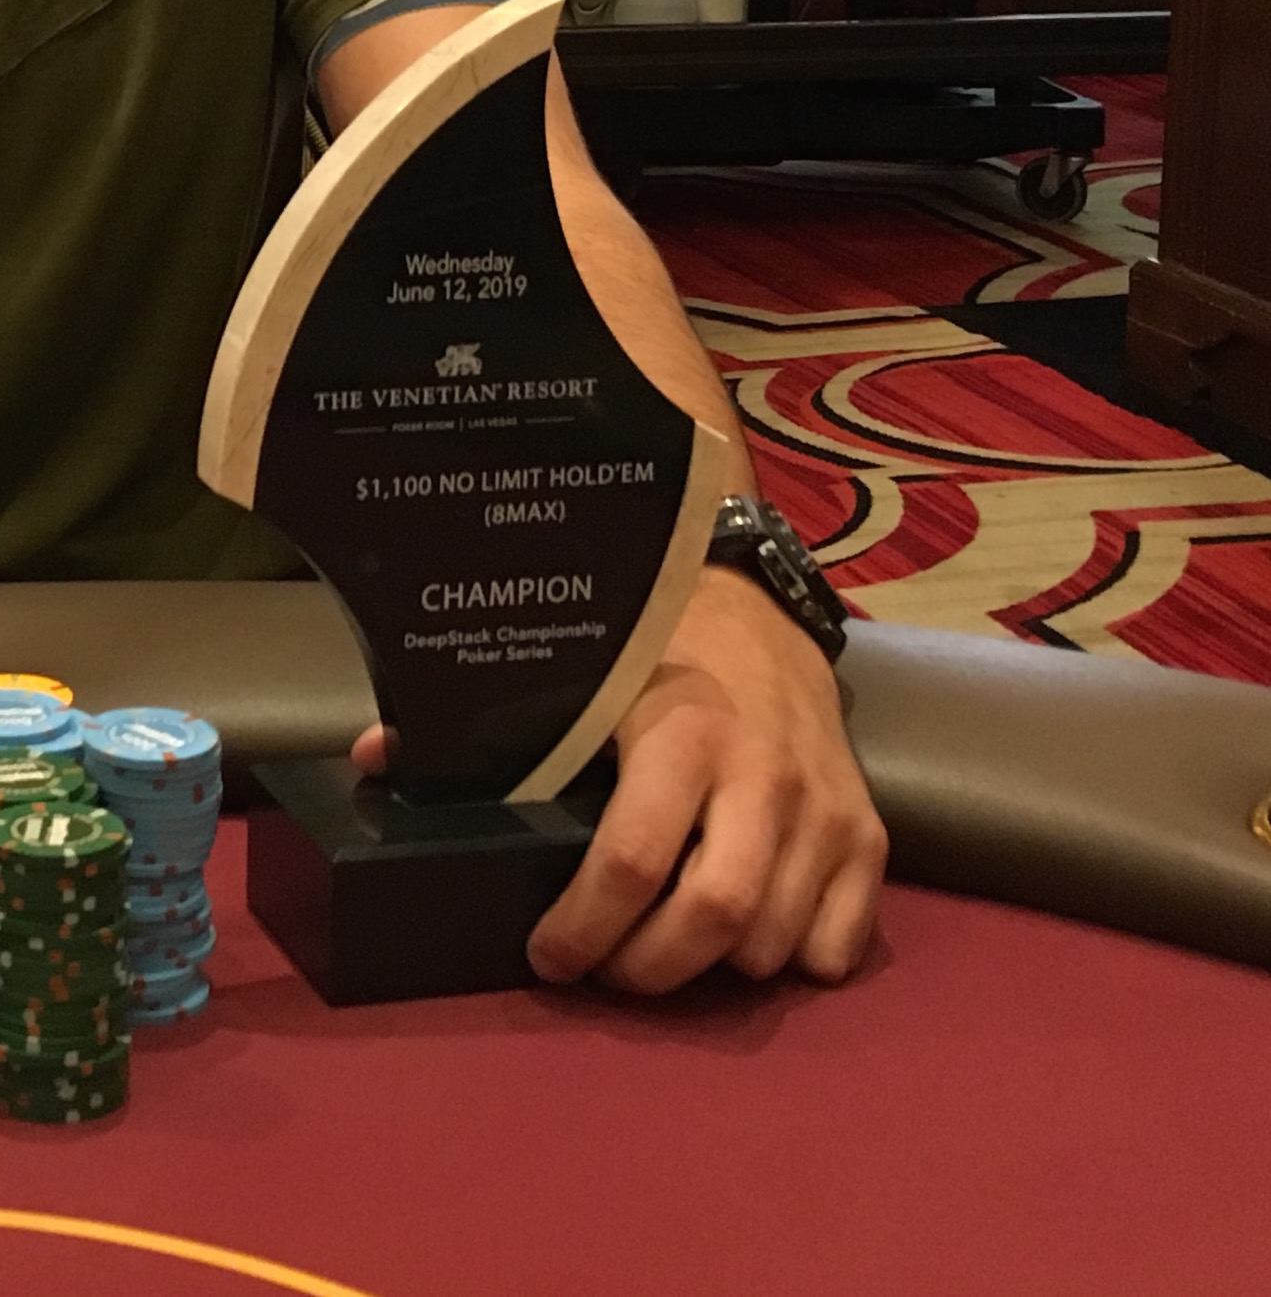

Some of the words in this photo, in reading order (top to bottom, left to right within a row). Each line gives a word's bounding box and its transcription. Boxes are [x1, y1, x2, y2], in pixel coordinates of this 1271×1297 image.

[405, 250, 515, 277] Wednesday
[386, 281, 436, 304] June
[443, 278, 472, 302] 12,
[478, 275, 527, 299] 2019
[314, 390, 363, 411] THE
[507, 378, 598, 400] RESORT
[425, 420, 455, 431] ROOM
[487, 416, 518, 428] VEGAS
[356, 476, 432, 501] $1,100
[439, 472, 475, 494] NO
[481, 467, 543, 492] LIMIT
[549, 462, 655, 488] HOLD'EM
[484, 500, 566, 527] (8MAX)
[421, 574, 593, 612] CHAMPION
[404, 627, 492, 651] DeepStack
[496, 621, 607, 644] Championship
[457, 647, 502, 664] Poker
[506, 645, 553, 662] Series
